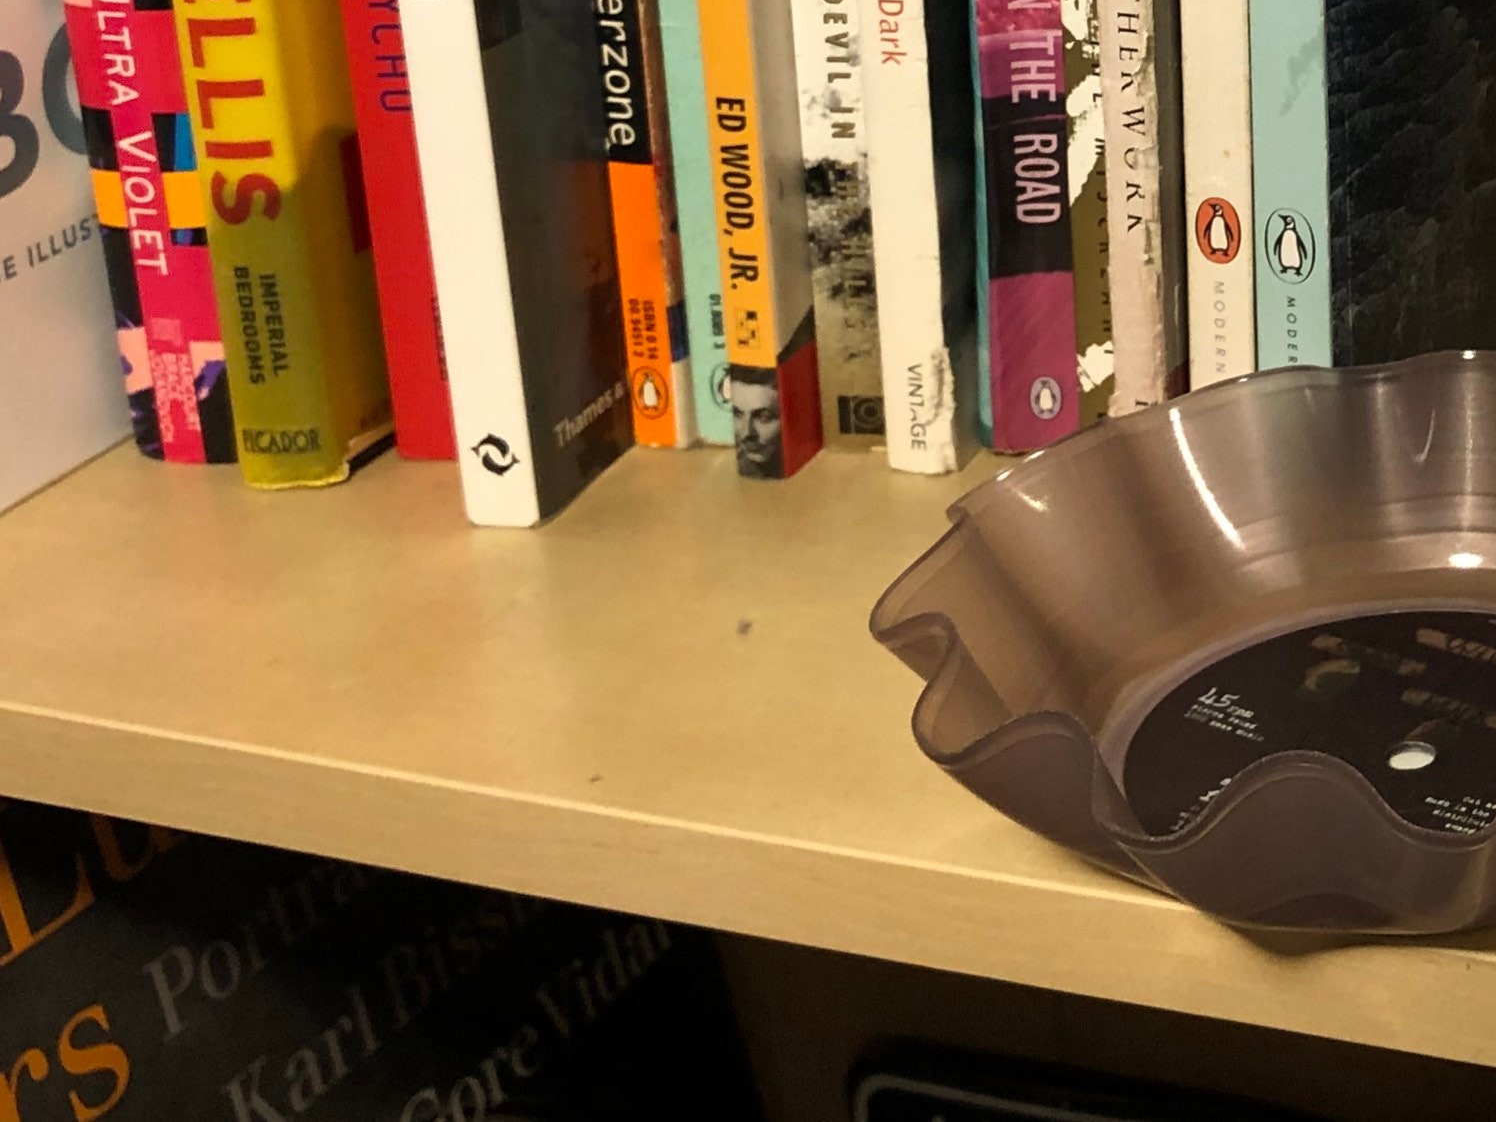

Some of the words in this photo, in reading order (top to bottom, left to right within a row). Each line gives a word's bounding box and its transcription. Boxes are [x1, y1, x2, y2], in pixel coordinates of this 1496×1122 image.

[1008, 28, 1063, 104] THE
[715, 96, 747, 133] ED
[116, 130, 169, 277] VIOLET
[719, 143, 755, 236] WOOD,
[1013, 132, 1062, 225] ROAD
[26, 214, 100, 269] ILLUS
[729, 249, 759, 290] JR.
[233, 265, 266, 386] BEDROOMS
[258, 273, 291, 378] IMPERIAL
[1213, 280, 1227, 373] MODERN
[1286, 295, 1299, 363] MODER
[241, 428, 322, 455] PICADOR
[905, 362, 929, 451] VINTGE
[221, 982, 383, 1122] Karl
